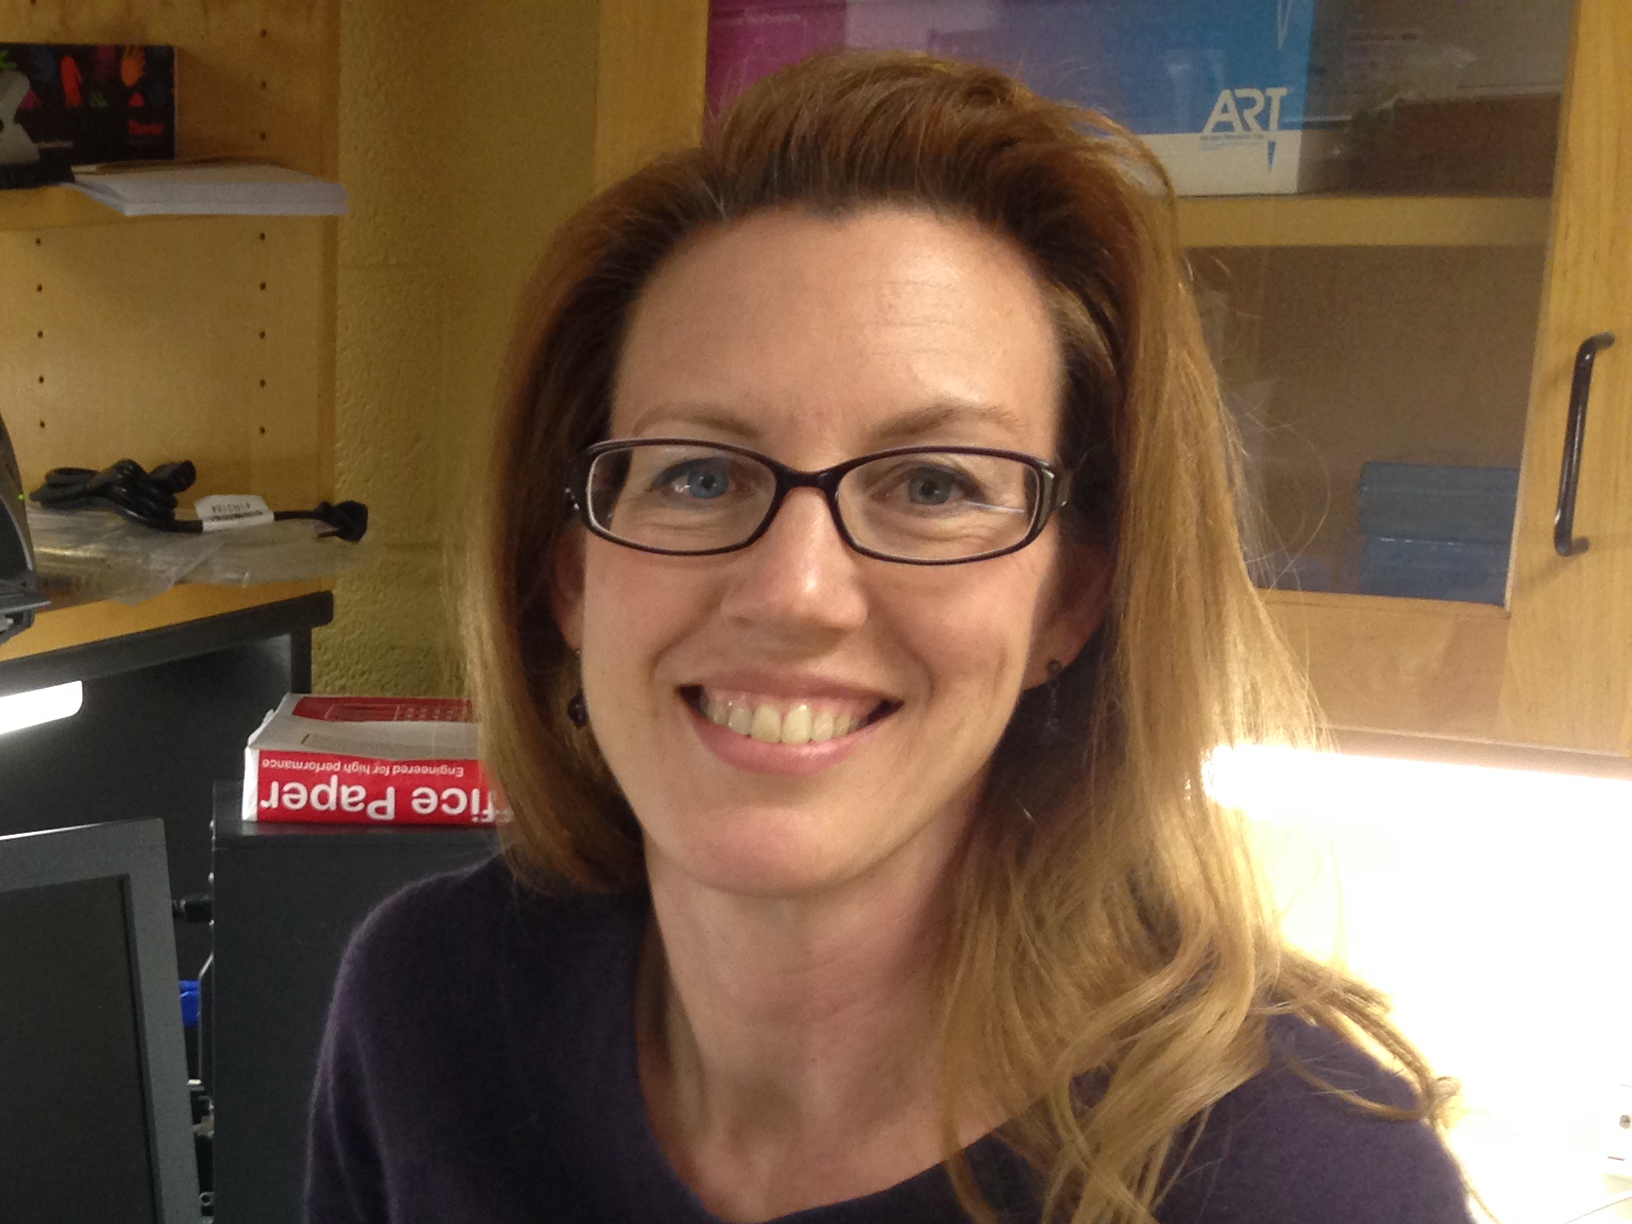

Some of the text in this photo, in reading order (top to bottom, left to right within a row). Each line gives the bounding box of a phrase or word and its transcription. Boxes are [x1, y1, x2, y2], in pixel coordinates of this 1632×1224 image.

[1201, 87, 1288, 134] ART
[261, 758, 464, 779] Engineered for high performance
[259, 774, 396, 821] Paper
